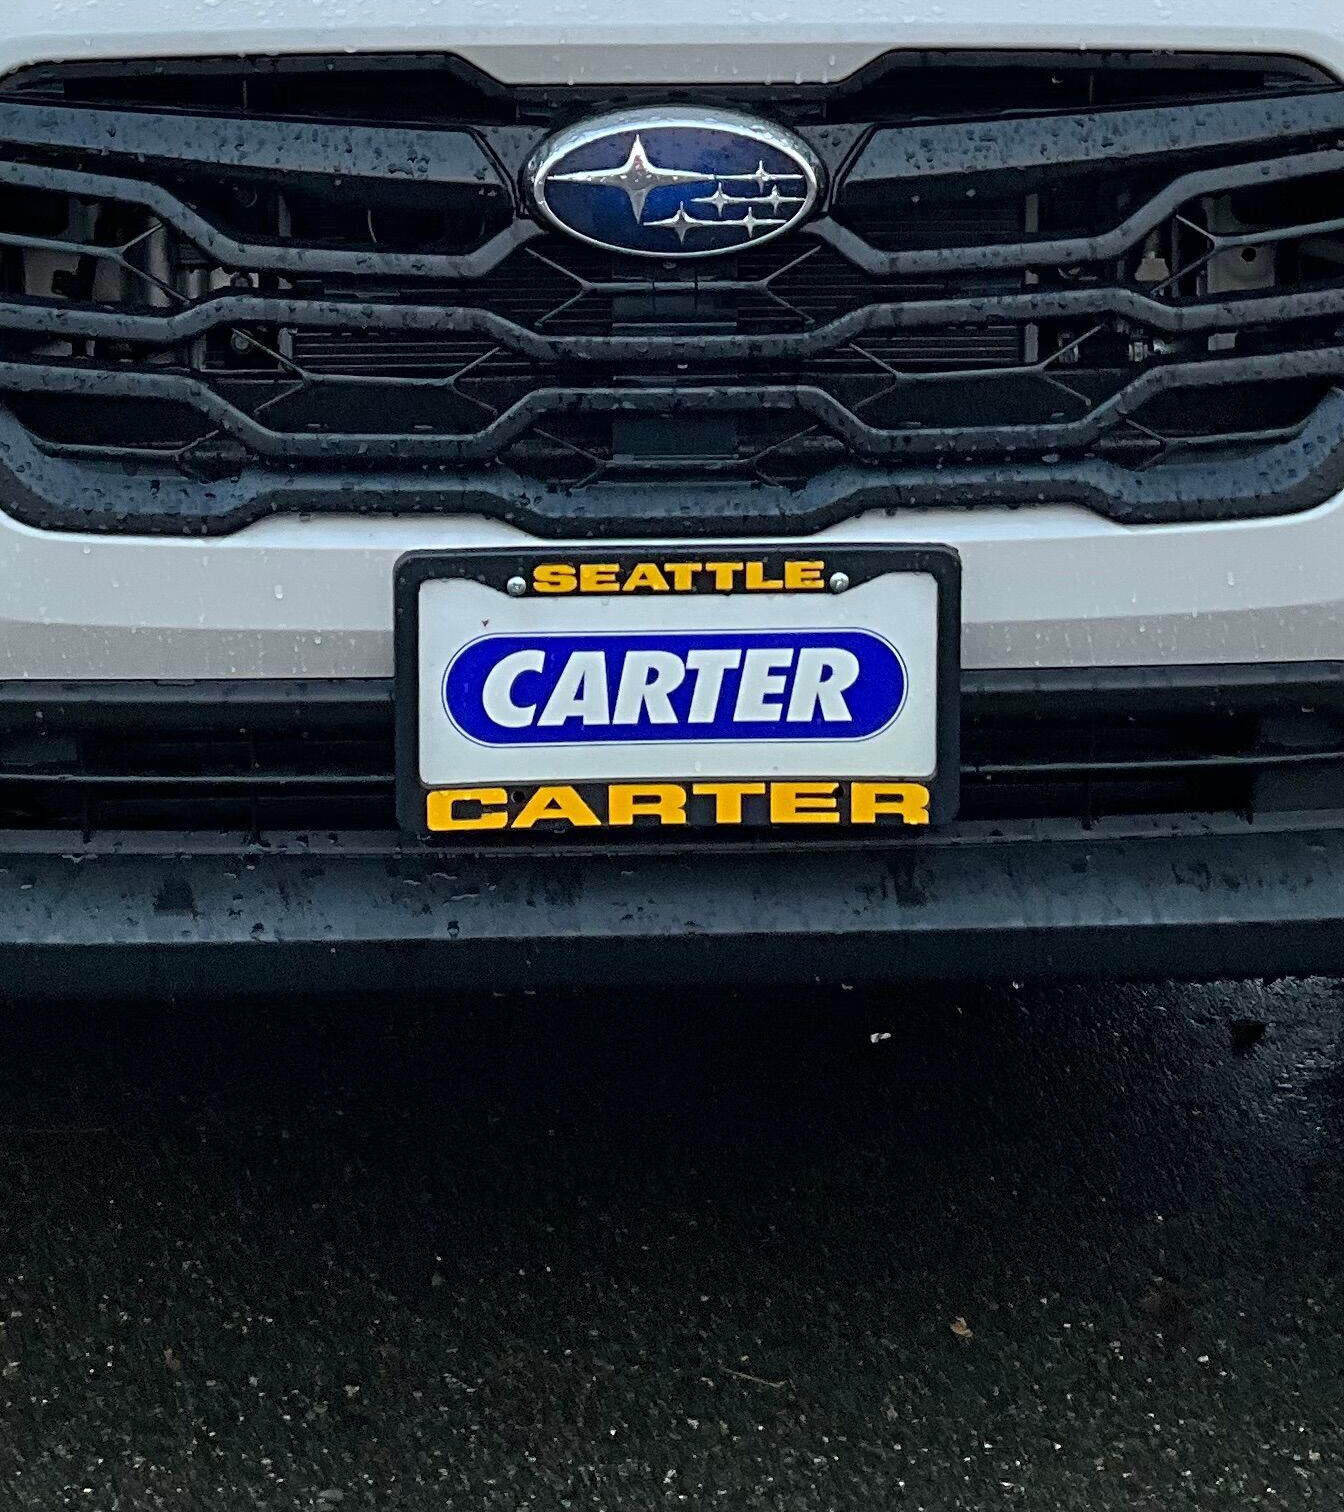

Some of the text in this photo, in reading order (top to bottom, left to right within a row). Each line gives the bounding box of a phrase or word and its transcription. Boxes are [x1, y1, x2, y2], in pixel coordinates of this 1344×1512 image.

[532, 560, 825, 594] SEATTLE
[481, 646, 861, 729] CARTER
[425, 781, 932, 833] CARTER
